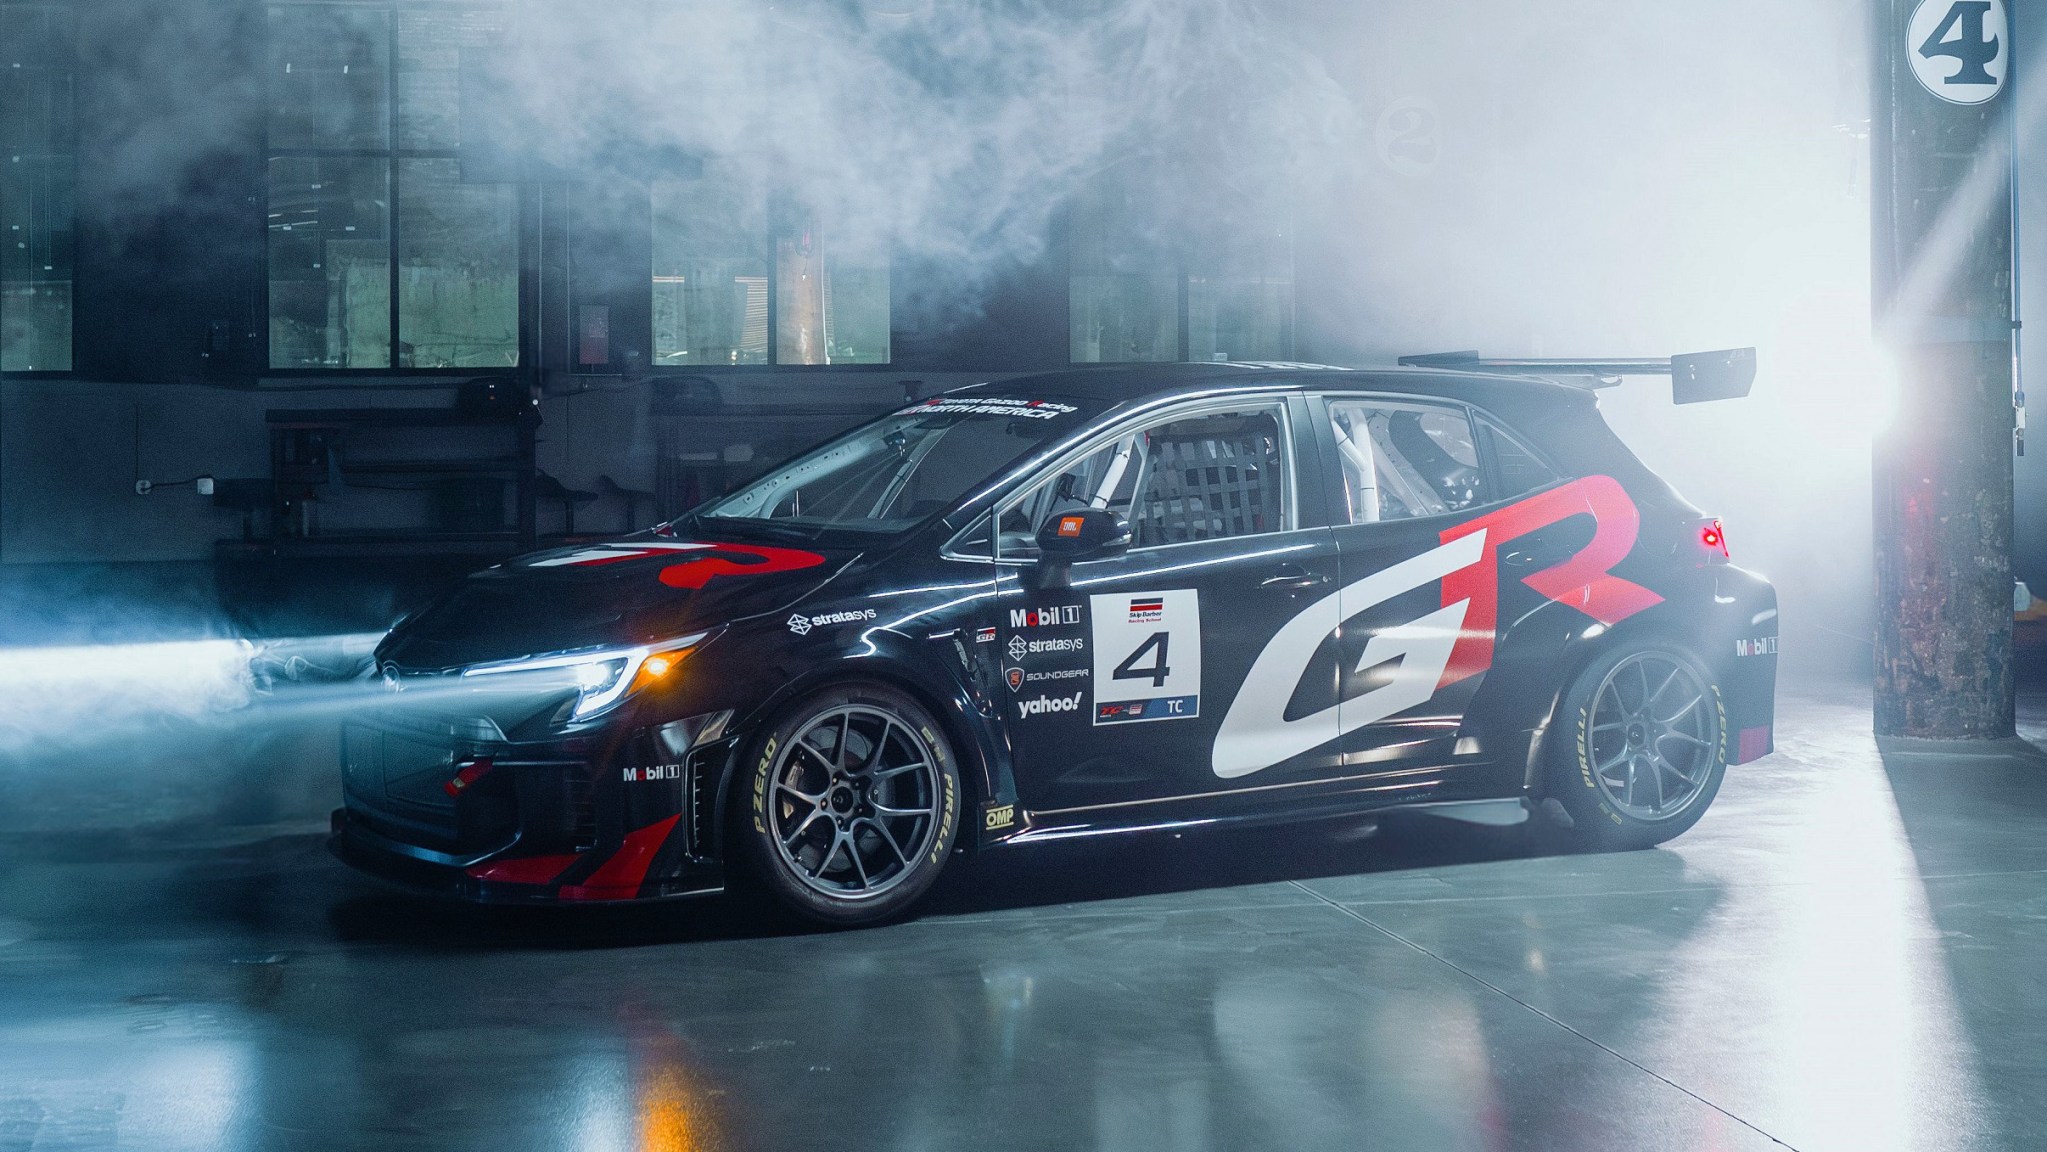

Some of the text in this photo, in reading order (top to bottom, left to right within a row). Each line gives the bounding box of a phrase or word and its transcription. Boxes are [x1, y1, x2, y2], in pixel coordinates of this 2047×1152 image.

[1918, 1, 1999, 85] 4
[1387, 106, 1437, 164] 2
[968, 405, 1060, 420] AMERICA
[811, 608, 877, 627] stratasys
[1010, 606, 1061, 628] Mobil
[1028, 638, 1084, 654] stratasys
[1736, 637, 1768, 656] Mobil
[1112, 631, 1171, 688] 4
[1026, 668, 1089, 681] SOUNDGEAR
[1018, 691, 1083, 719] yahoo!
[1167, 699, 1184, 714] TC
[1577, 707, 1595, 788] PIRELLI
[623, 766, 664, 782] Mobil
[753, 737, 777, 814] ZERO
[930, 773, 954, 864] PIRELLI
[986, 807, 1014, 828] OMP
